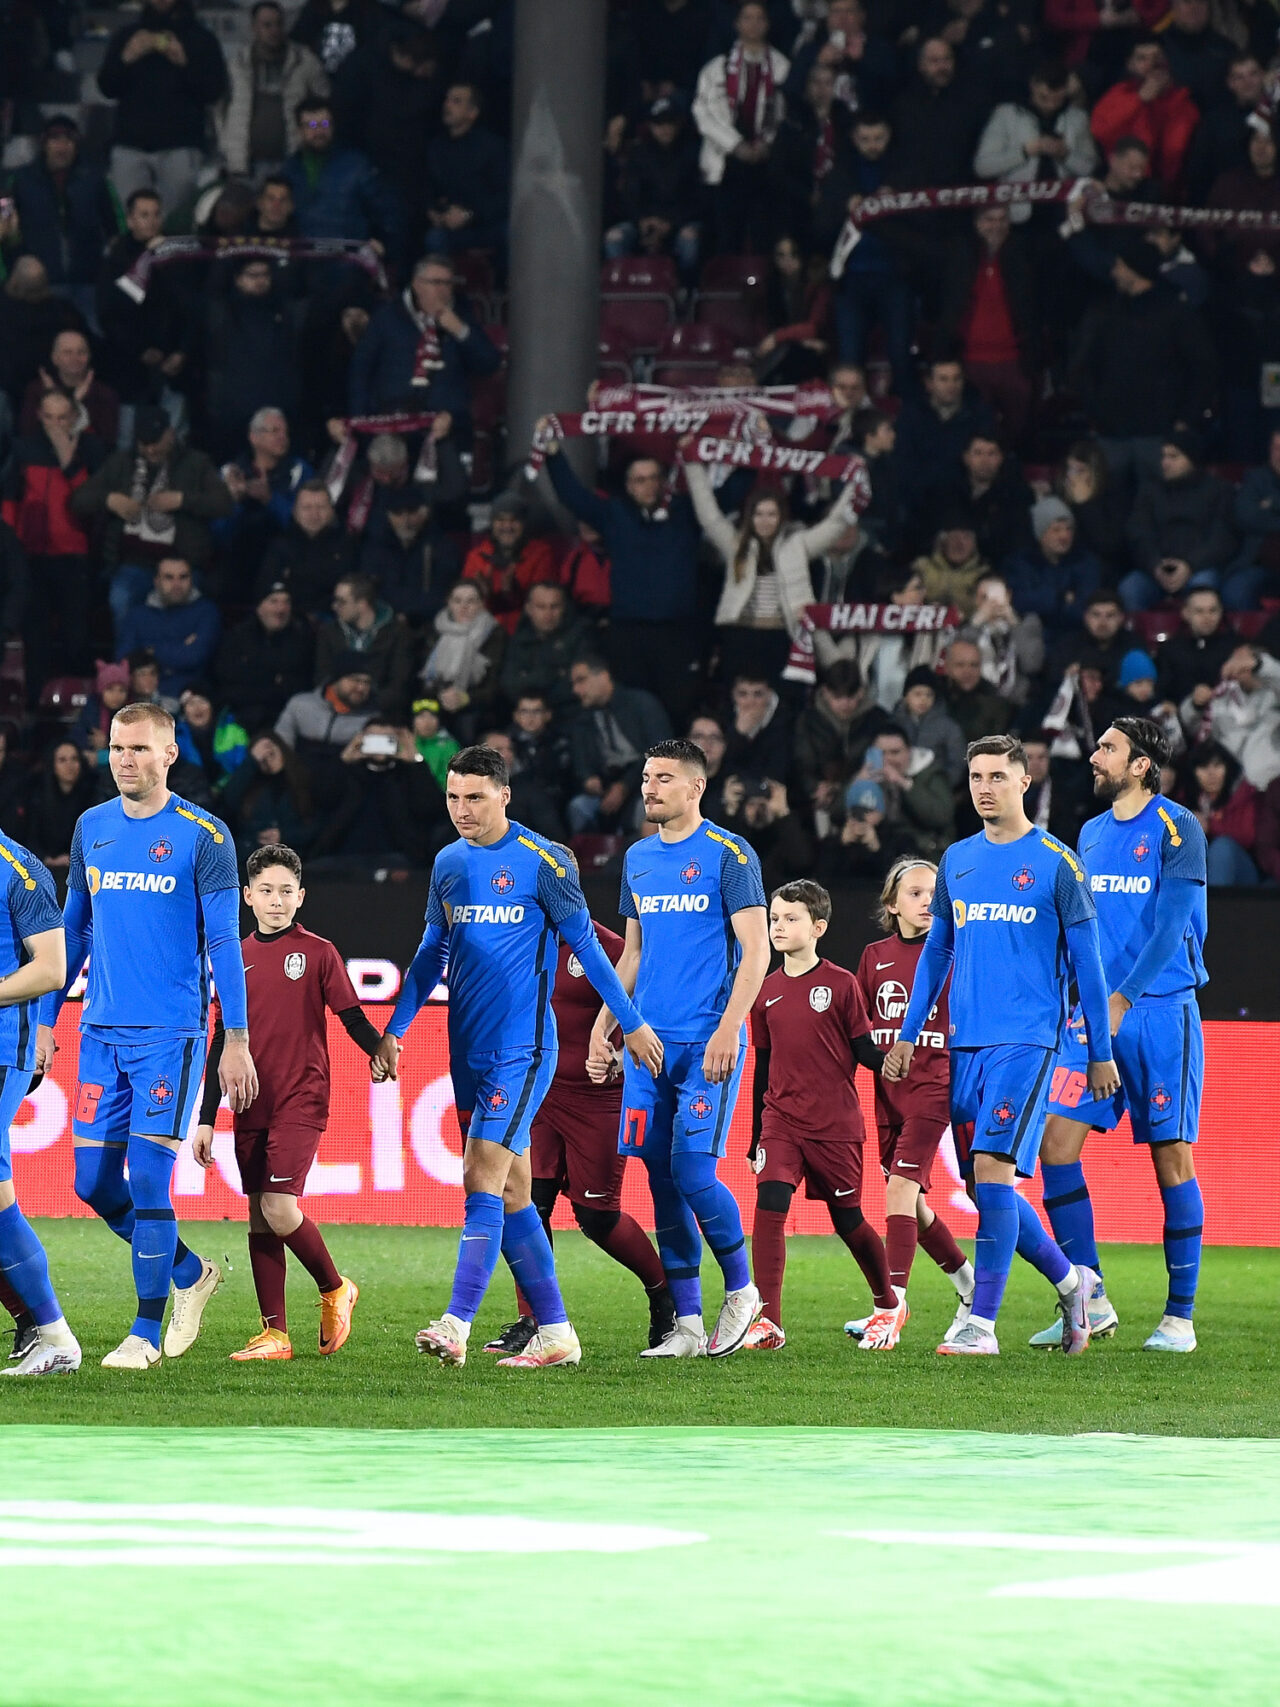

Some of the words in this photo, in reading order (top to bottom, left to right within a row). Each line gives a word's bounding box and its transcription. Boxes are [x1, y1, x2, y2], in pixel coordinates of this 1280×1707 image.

[936, 186, 989, 205] CFR
[994, 181, 1062, 202] CLUJ
[580, 411, 637, 433] CFR
[642, 411, 710, 434] 1907
[697, 437, 753, 465] CFR
[759, 444, 827, 473] 1907
[830, 604, 878, 629] HAI
[881, 604, 949, 629] CFR!
[101, 870, 177, 893] BETANO
[1090, 874, 1151, 894] BETANO
[452, 905, 525, 924] BETANO
[641, 894, 710, 914] BETANO
[966, 901, 1037, 924] BETANO
[1048, 1066, 1088, 1109] 96
